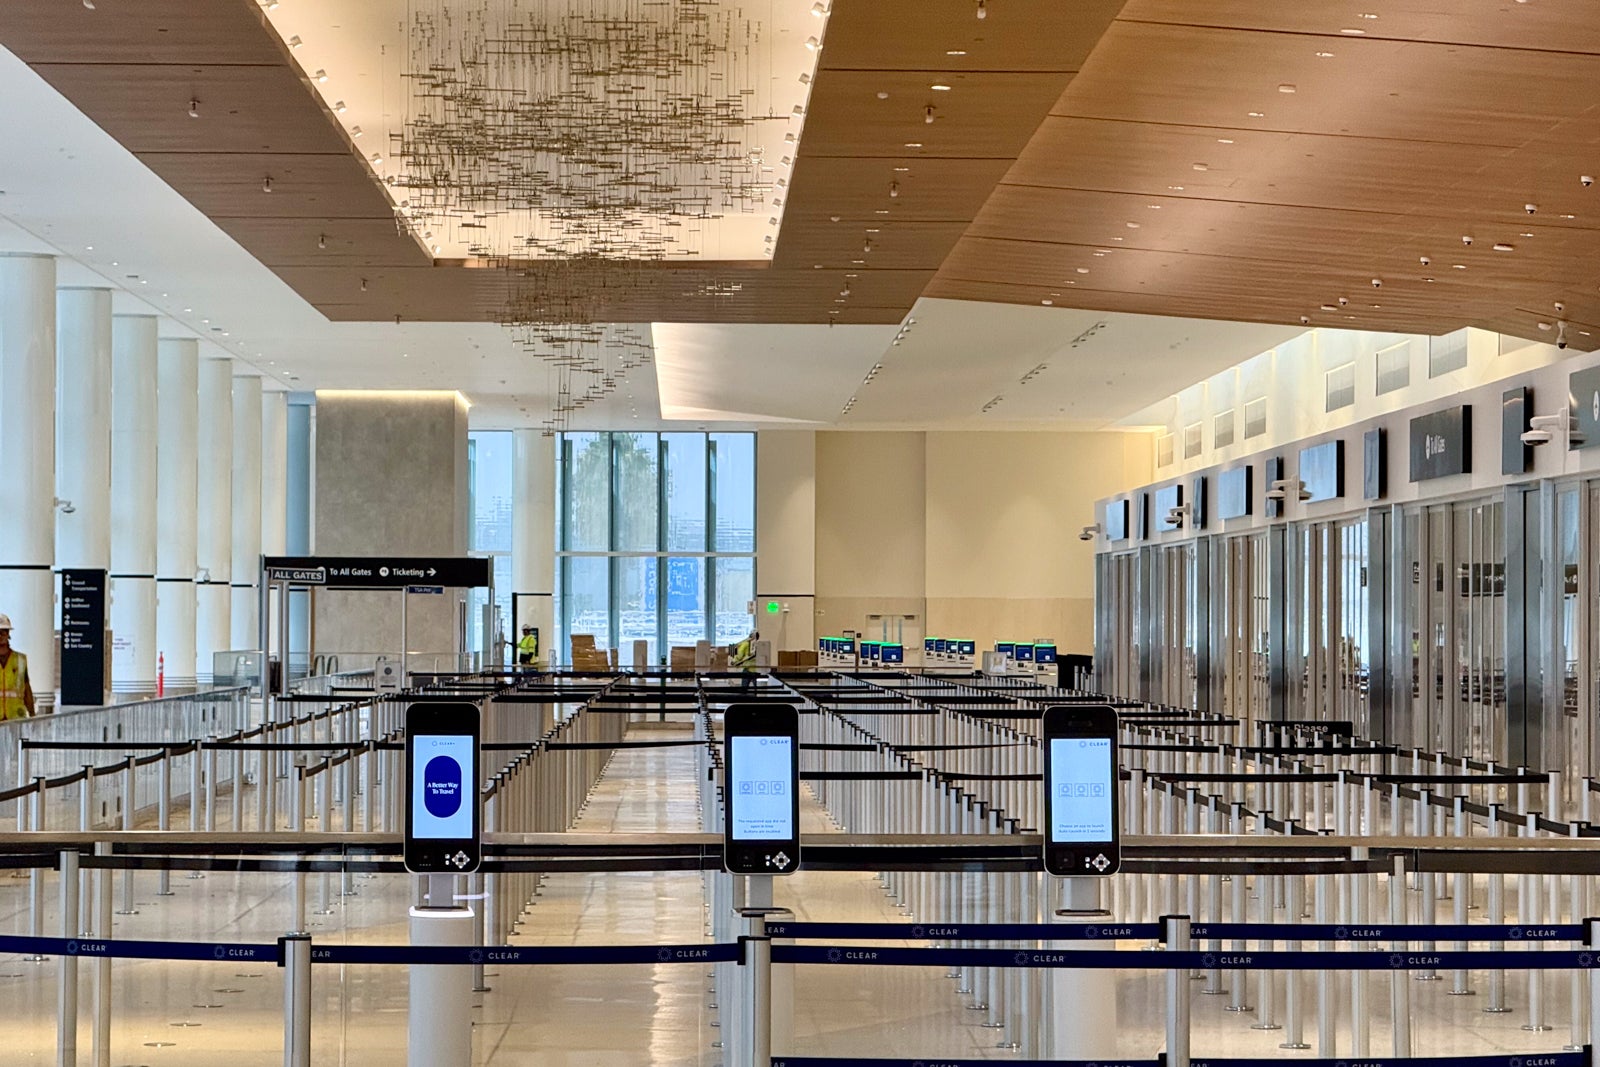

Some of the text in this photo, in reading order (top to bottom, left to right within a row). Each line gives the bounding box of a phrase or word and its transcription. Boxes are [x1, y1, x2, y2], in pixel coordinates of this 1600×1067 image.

[274, 571, 322, 580] ALL GATES
[330, 568, 372, 576] To All Gates
[392, 568, 424, 578] Ticketing
[928, 928, 958, 936] CLEAR
[1352, 929, 1381, 937] CLEAR
[81, 943, 106, 952] CLEAR
[229, 949, 255, 957] CLEAR
[488, 951, 520, 960] CLEAR
[676, 950, 708, 959] CLEAR
[846, 951, 878, 960] CLEAR
[1033, 955, 1065, 963] CLEAR
[1220, 956, 1252, 965] CLEAR
[1408, 957, 1440, 965] CLEAR
[1526, 1058, 1556, 1067] CLEAR
